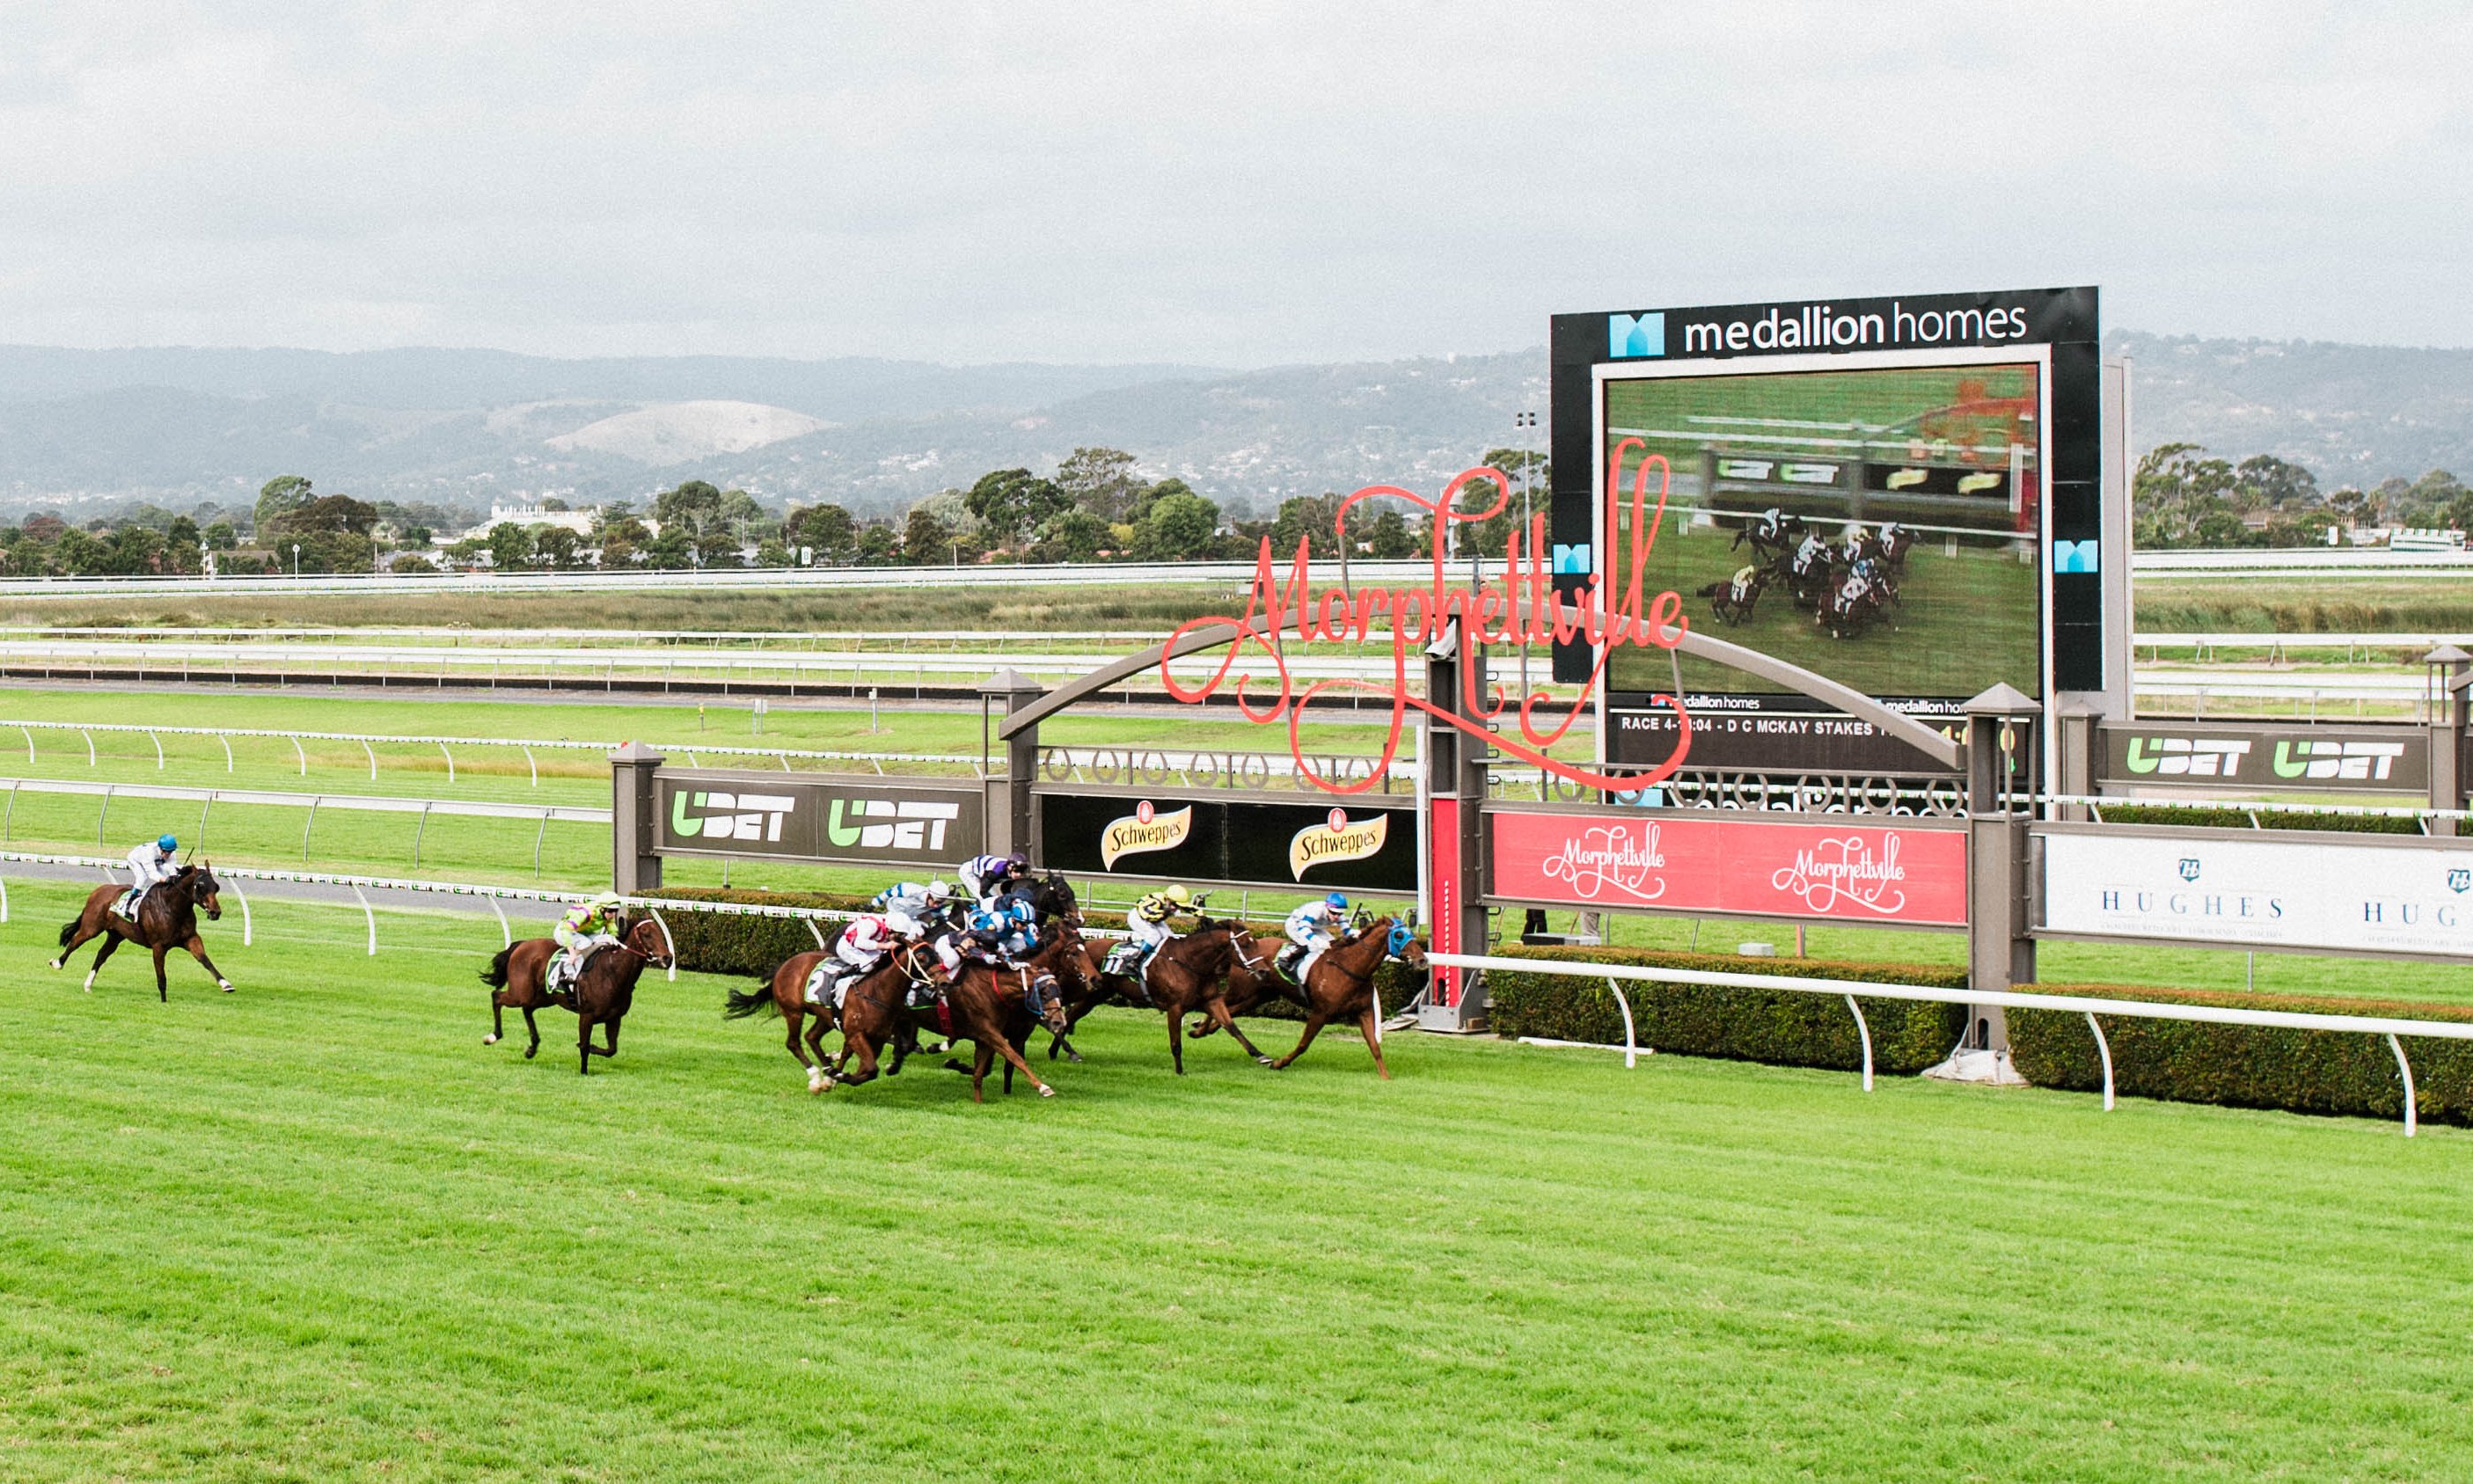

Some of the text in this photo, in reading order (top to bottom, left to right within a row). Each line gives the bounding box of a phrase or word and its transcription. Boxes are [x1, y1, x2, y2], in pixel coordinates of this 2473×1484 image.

[1685, 301, 2026, 351] medallion homes
[1161, 436, 1693, 793] Morphettville
[1669, 695, 1760, 709] dallion homes
[1621, 716, 1659, 731] RACE
[1727, 720, 1738, 733] D
[1742, 720, 1752, 733] C
[1757, 720, 1809, 734] MCKAY
[1815, 721, 1873, 736] STAKES
[2126, 737, 2251, 776] UBET
[2273, 741, 2404, 780] UBET
[672, 791, 795, 842] UBET
[828, 799, 959, 851] UBET
[1111, 821, 1182, 852] Schweppes
[1301, 830, 1377, 861] Schweppes
[1542, 821, 1665, 899] Morphettville
[1772, 830, 1906, 913] Morphettville
[2102, 890, 2283, 919] HUGHES
